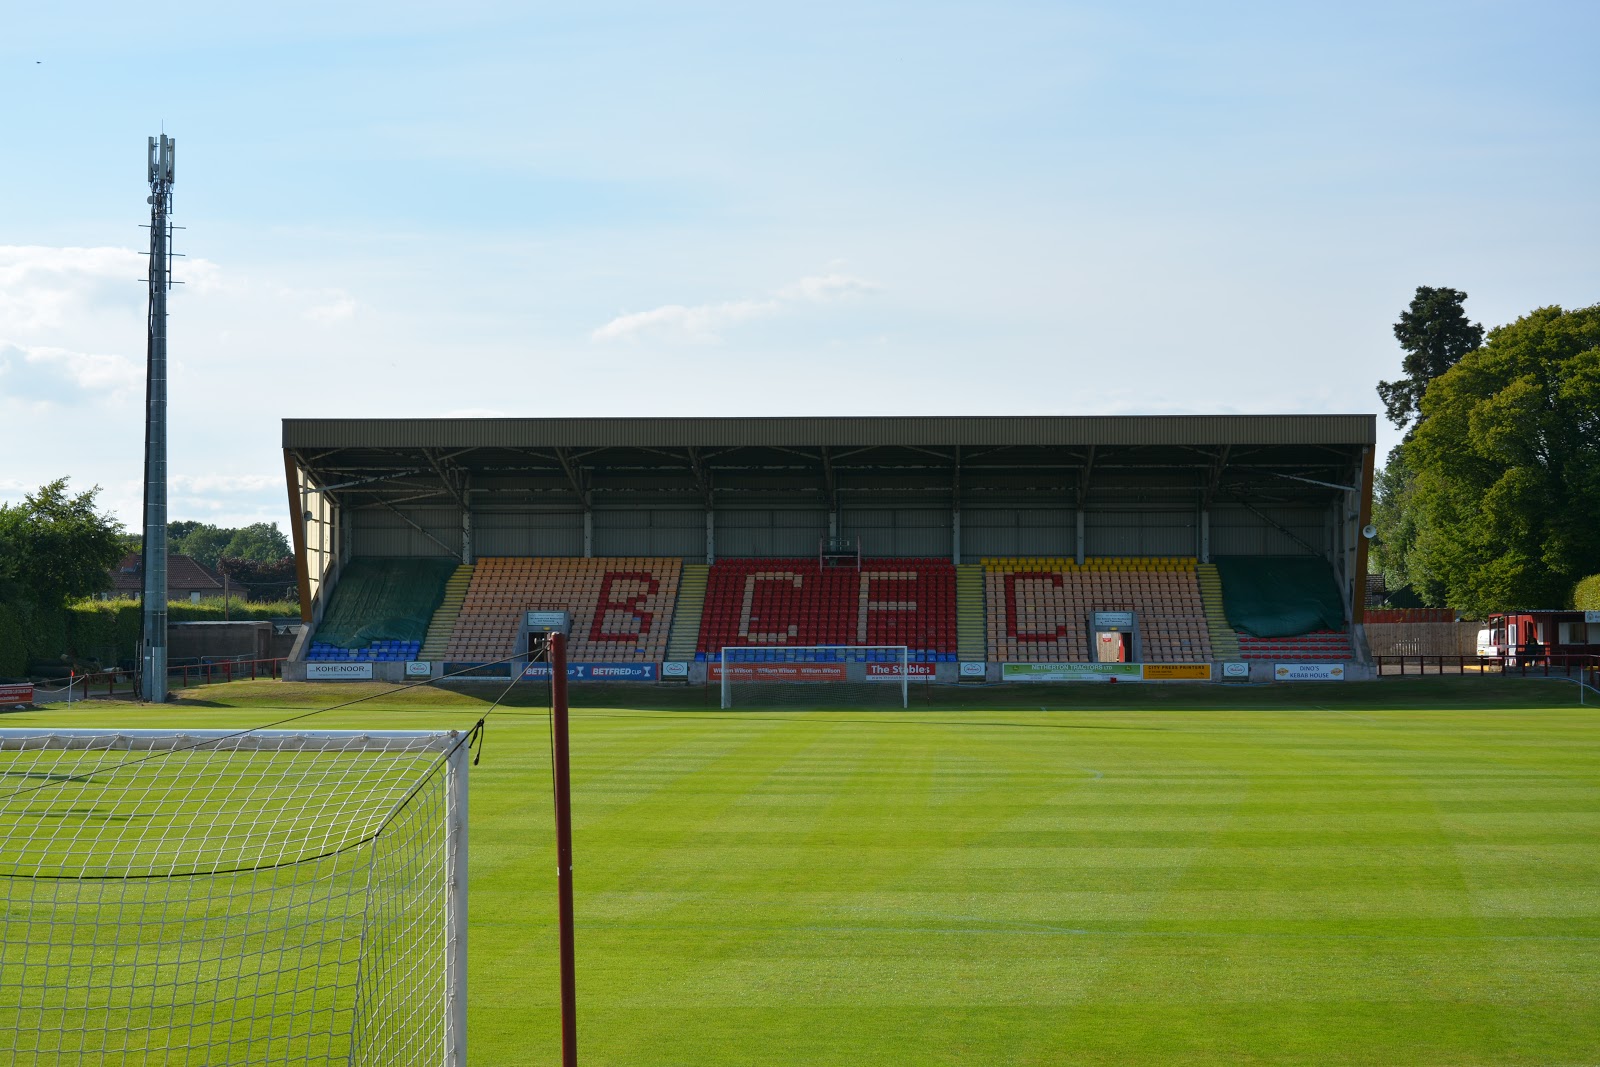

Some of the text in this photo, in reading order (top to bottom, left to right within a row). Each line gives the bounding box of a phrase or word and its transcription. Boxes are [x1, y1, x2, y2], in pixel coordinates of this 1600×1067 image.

[589, 571, 1066, 643] B C F C
[525, 667, 552, 675] BETFR
[592, 667, 631, 676] BETFRED
[871, 665, 930, 674] The Stbles
